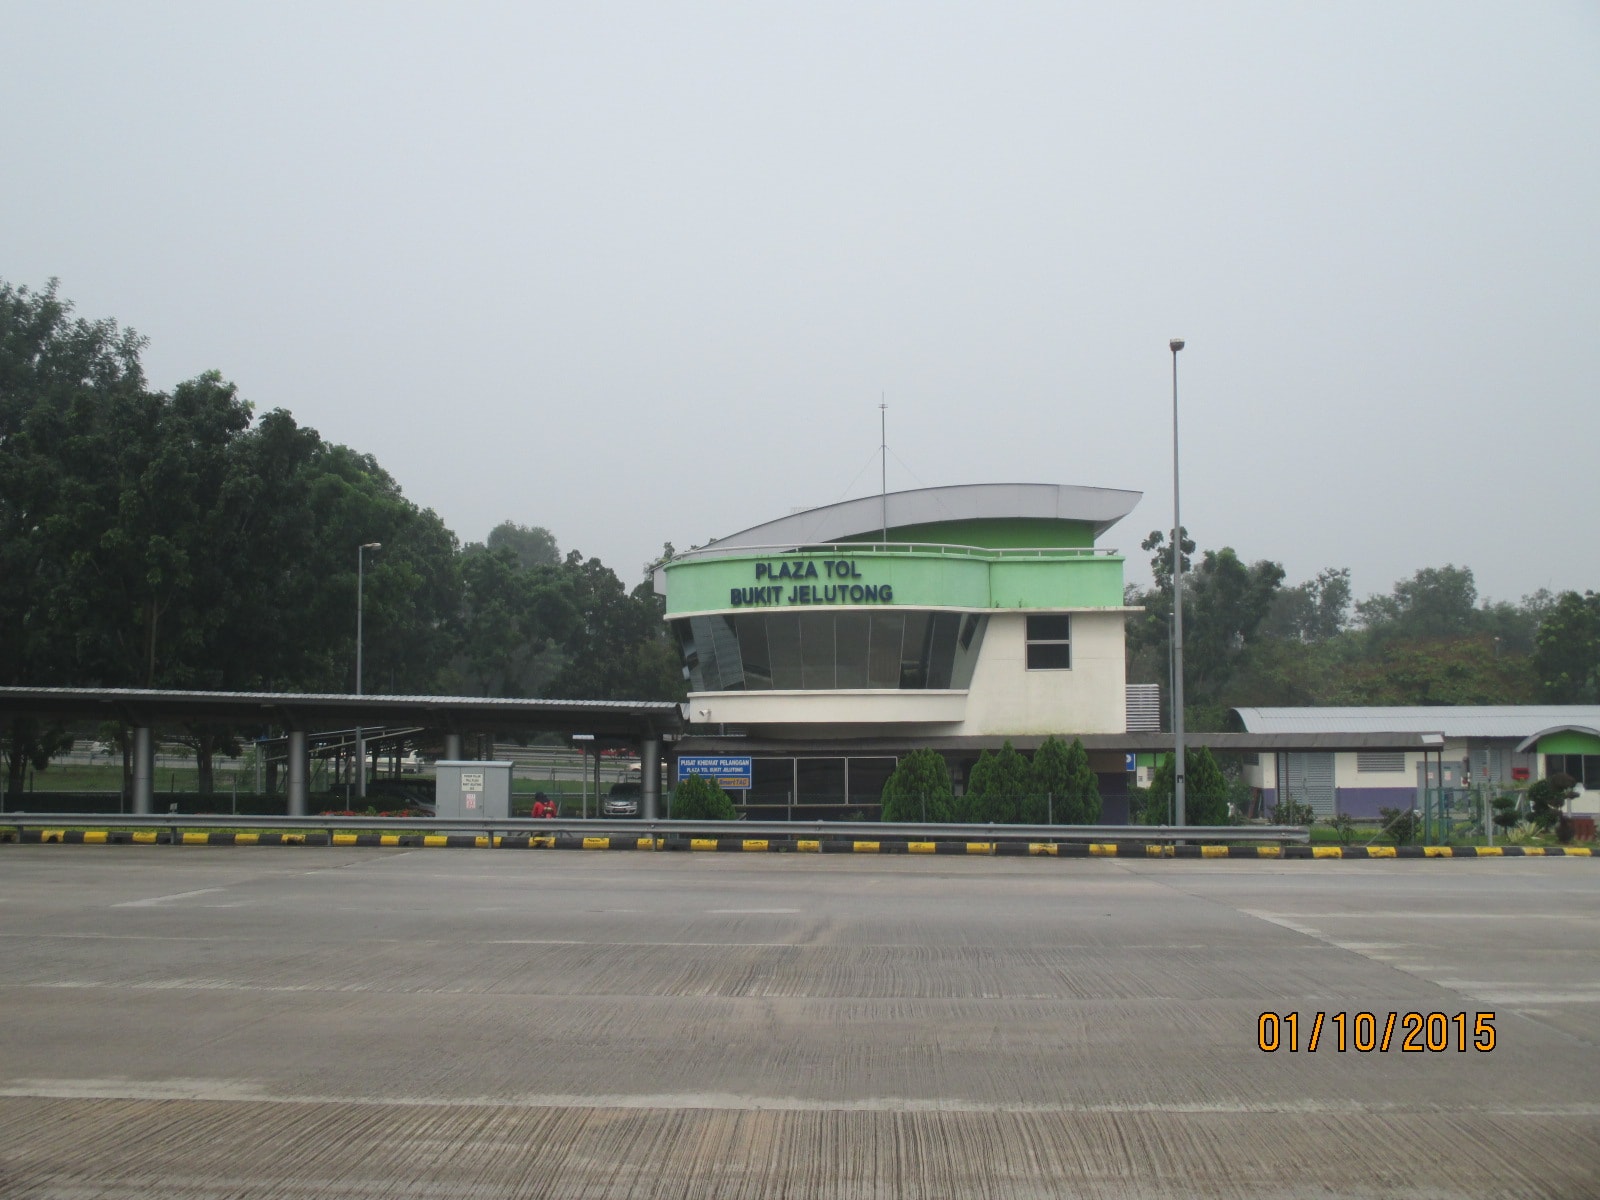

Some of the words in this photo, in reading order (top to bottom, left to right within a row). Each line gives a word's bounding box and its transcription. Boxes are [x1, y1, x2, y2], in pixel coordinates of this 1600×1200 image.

[755, 560, 818, 580] PLAZA
[824, 560, 862, 578] TOL
[730, 585, 784, 605] BUKIT
[788, 584, 893, 603] JELUTONG
